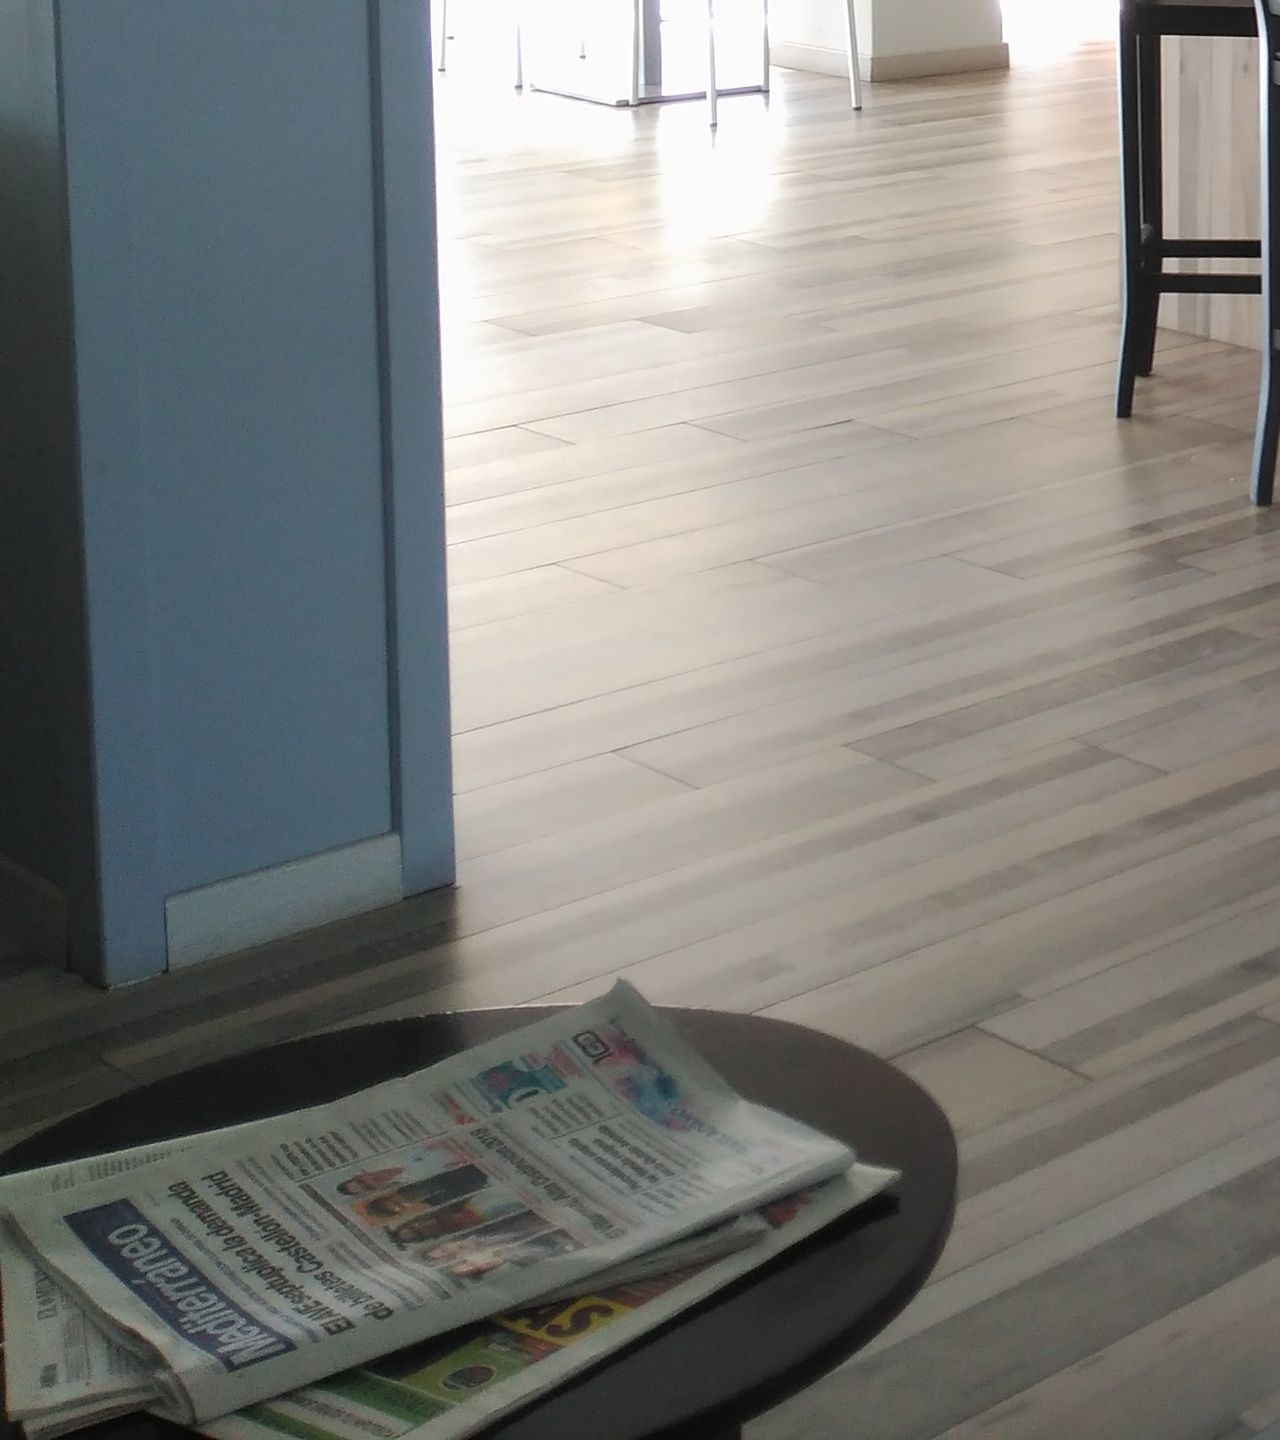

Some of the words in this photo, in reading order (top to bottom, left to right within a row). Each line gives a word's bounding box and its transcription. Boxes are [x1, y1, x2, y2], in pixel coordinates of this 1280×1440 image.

[168, 1180, 236, 1238] demanda
[221, 1234, 247, 1252] la
[108, 1223, 287, 1365] Mediterráneo
[313, 1269, 373, 1308] billetes
[294, 1297, 336, 1323] AVE
[362, 1299, 394, 1320] de
[320, 1314, 356, 1336] El
